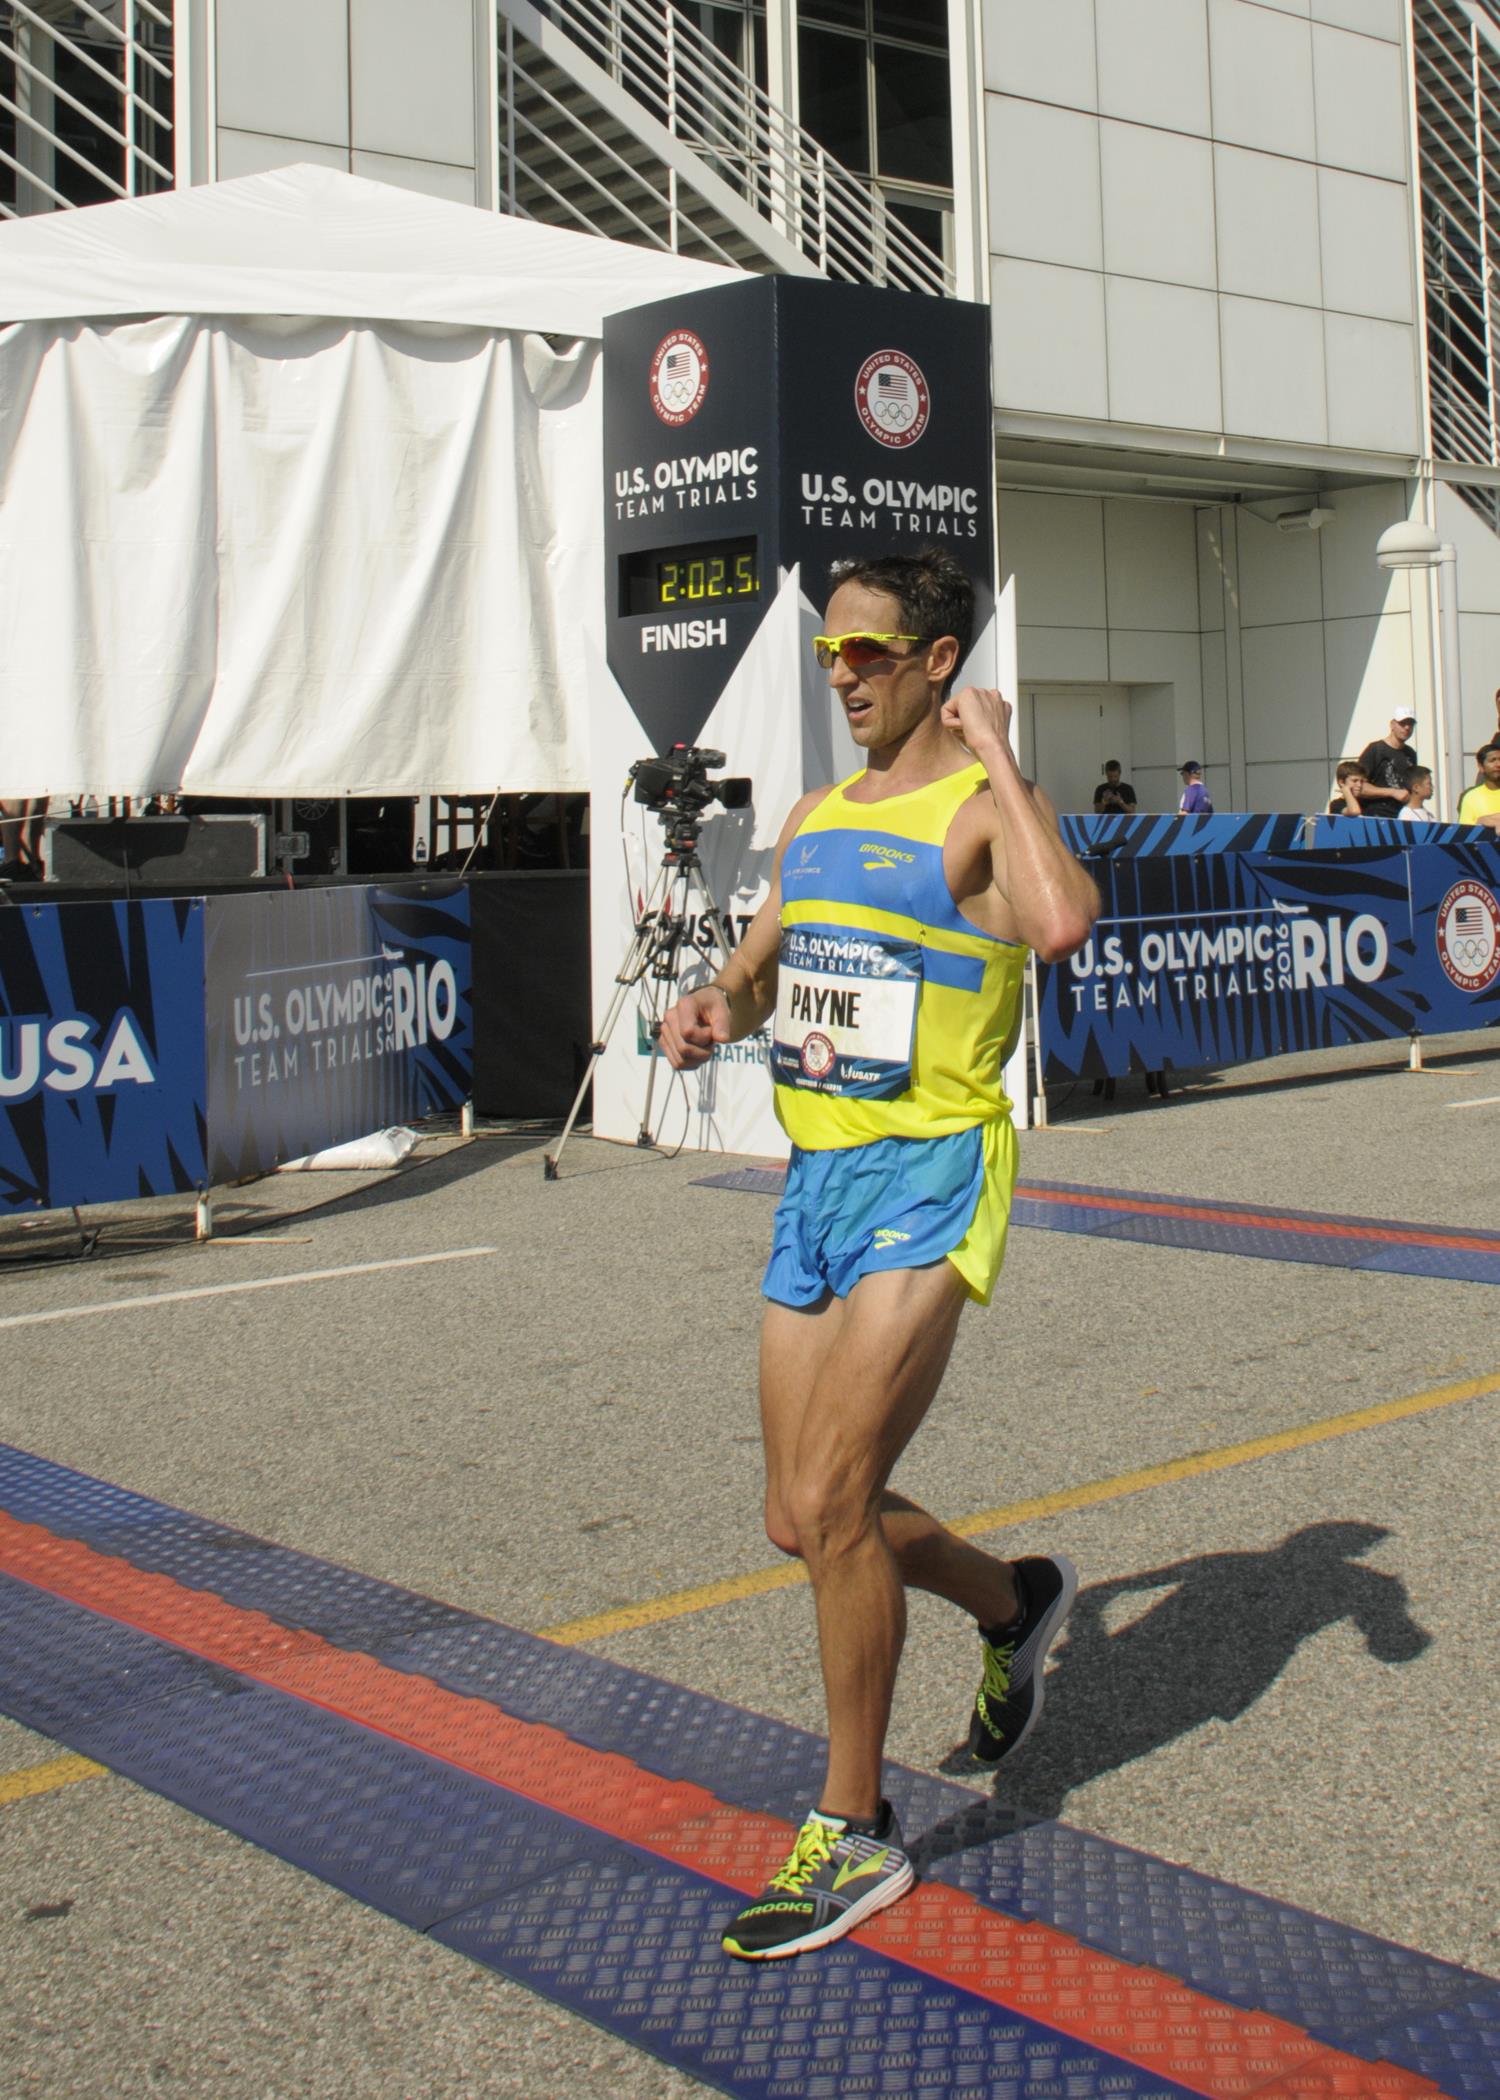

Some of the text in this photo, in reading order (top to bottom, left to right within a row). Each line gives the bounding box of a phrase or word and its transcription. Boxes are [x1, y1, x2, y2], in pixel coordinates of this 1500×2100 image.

[654, 333, 703, 366] UNITED STATES
[862, 354, 922, 385] UNITED STATES
[653, 384, 706, 422] OLYMPIC TEAM
[861, 407, 926, 444] OLYMPIC TEAM
[615, 446, 759, 498] U.S. OLYMPIC
[615, 479, 757, 520] TEAM TRIALS
[801, 473, 978, 515] U.S. OLYMPIC
[801, 505, 977, 538] TEAM TRIALS
[641, 618, 727, 653] FINISH
[858, 843, 916, 864] BROOKS
[1440, 884, 1496, 918] UNITED STATES
[788, 952, 881, 976] TEAM TRIALS
[790, 934, 884, 961] U.S. OLYMPIC
[1070, 924, 1274, 978] U.S. OLYMPIC
[1276, 914, 1388, 990] 2016 RIO
[1441, 947, 1500, 987] OLYMPIC TEAM
[384, 959, 457, 1051] 2016 RIO
[790, 983, 862, 1029] PAYNE
[1071, 967, 1275, 1012] TEAM TRIALS
[233, 974, 385, 1046] U.S. OLYMPIC
[0, 1015, 156, 1097] USA
[234, 1026, 384, 1089] TEAM TRIALS
[736, 1901, 815, 1921] BROOKS
